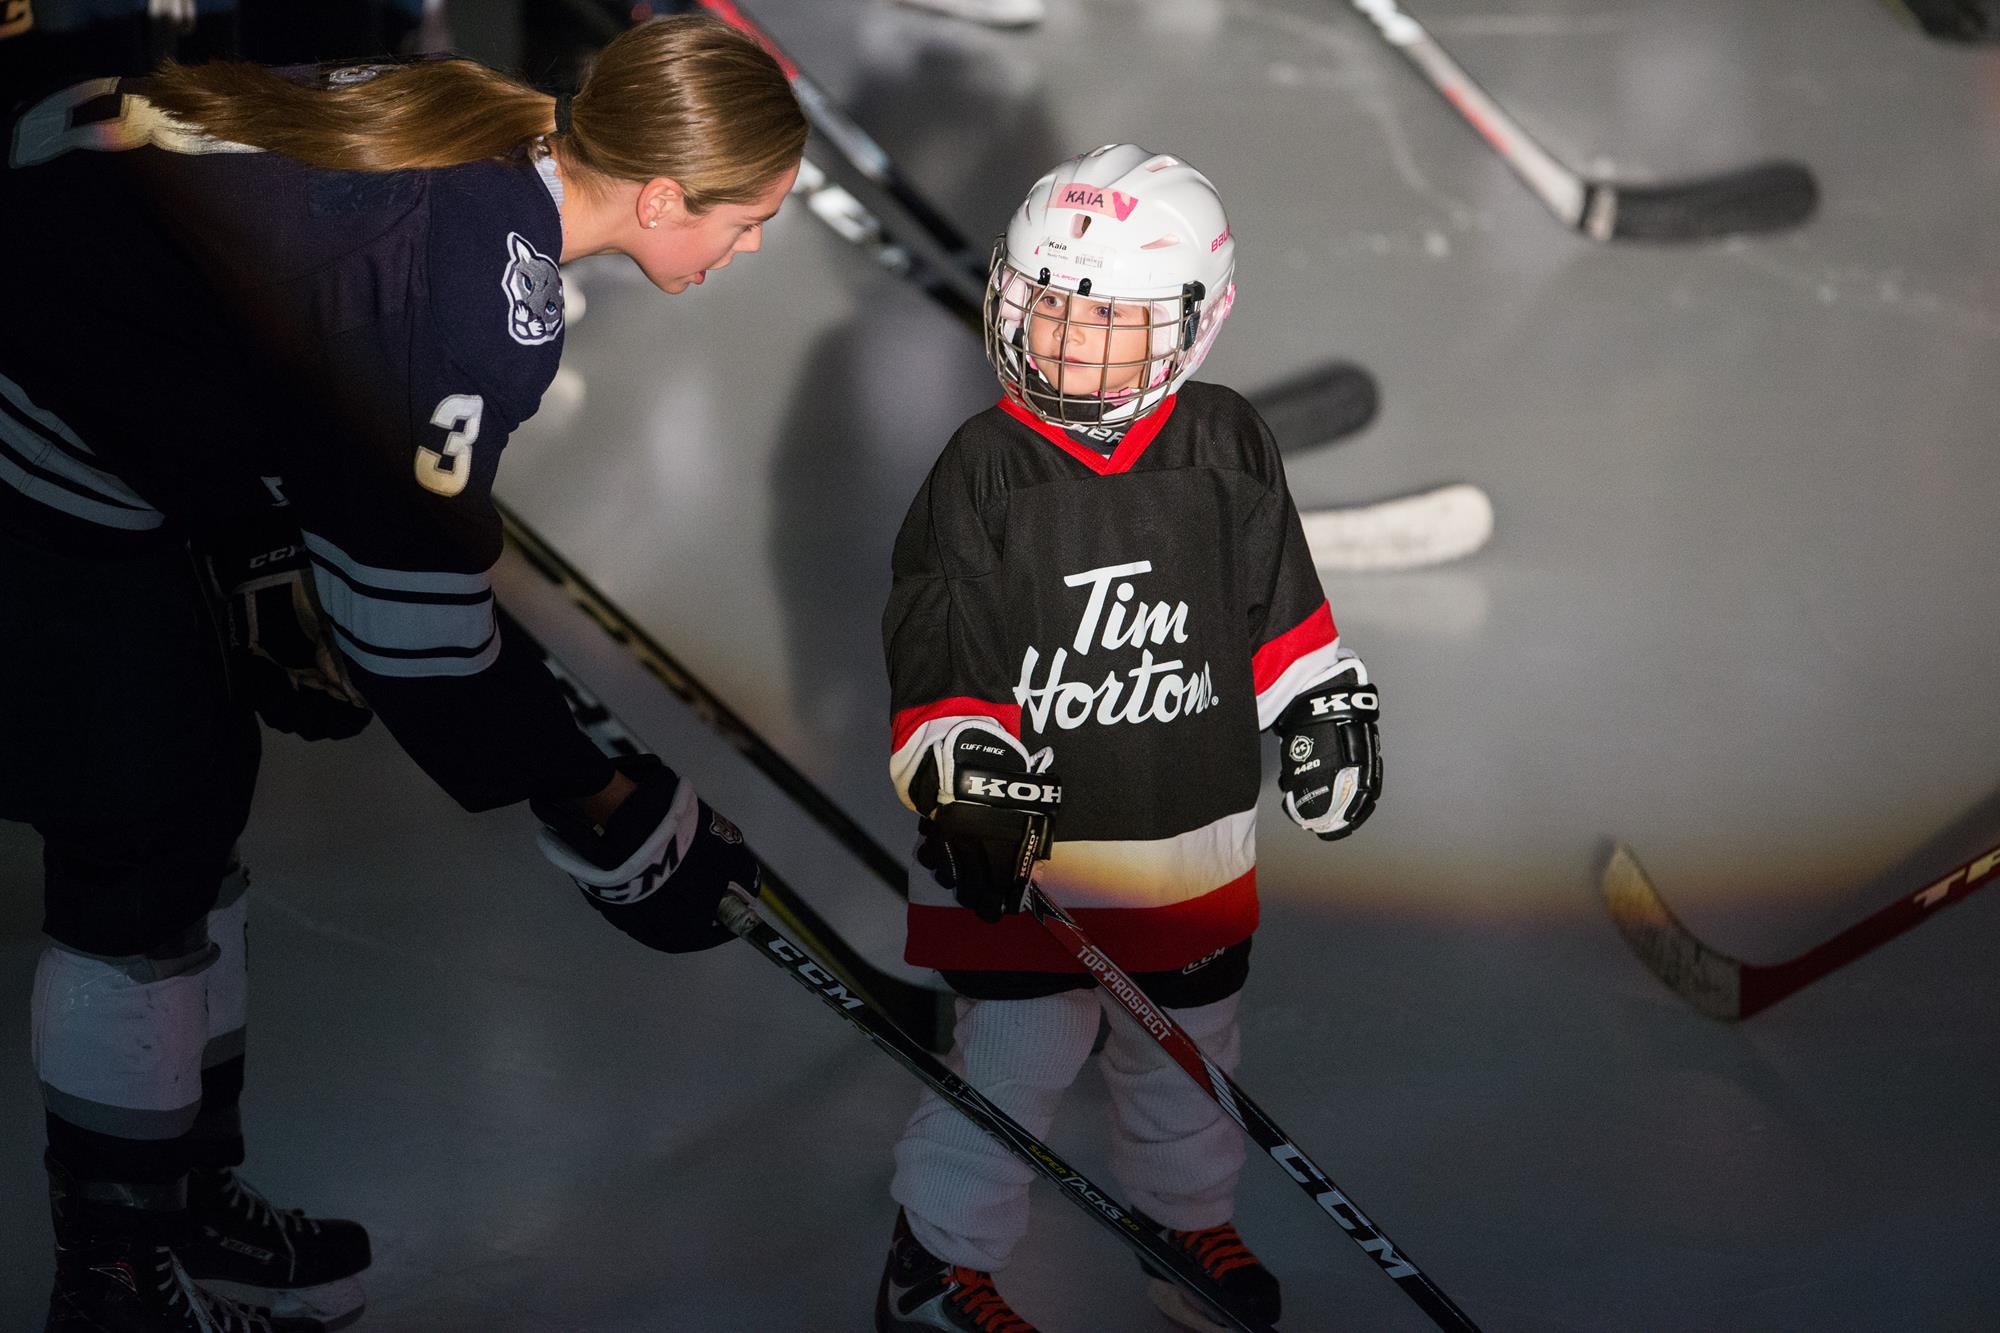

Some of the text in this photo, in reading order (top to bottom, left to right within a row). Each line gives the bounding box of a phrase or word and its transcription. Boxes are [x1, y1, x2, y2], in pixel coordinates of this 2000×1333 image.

[1065, 190, 1104, 208] KAIA
[1048, 241, 1067, 251] Kaia
[414, 393, 484, 498] 3
[1063, 560, 1189, 656] Tim
[1310, 692, 1379, 716] KO
[960, 743, 1006, 756] CUFF HINGE
[1293, 759, 1321, 776] 4420
[1076, 945, 1107, 972] TOP
[768, 937, 865, 1011] CCM
[1062, 1171, 1124, 1220] TACKS
[1270, 1143, 1420, 1279] CCM
